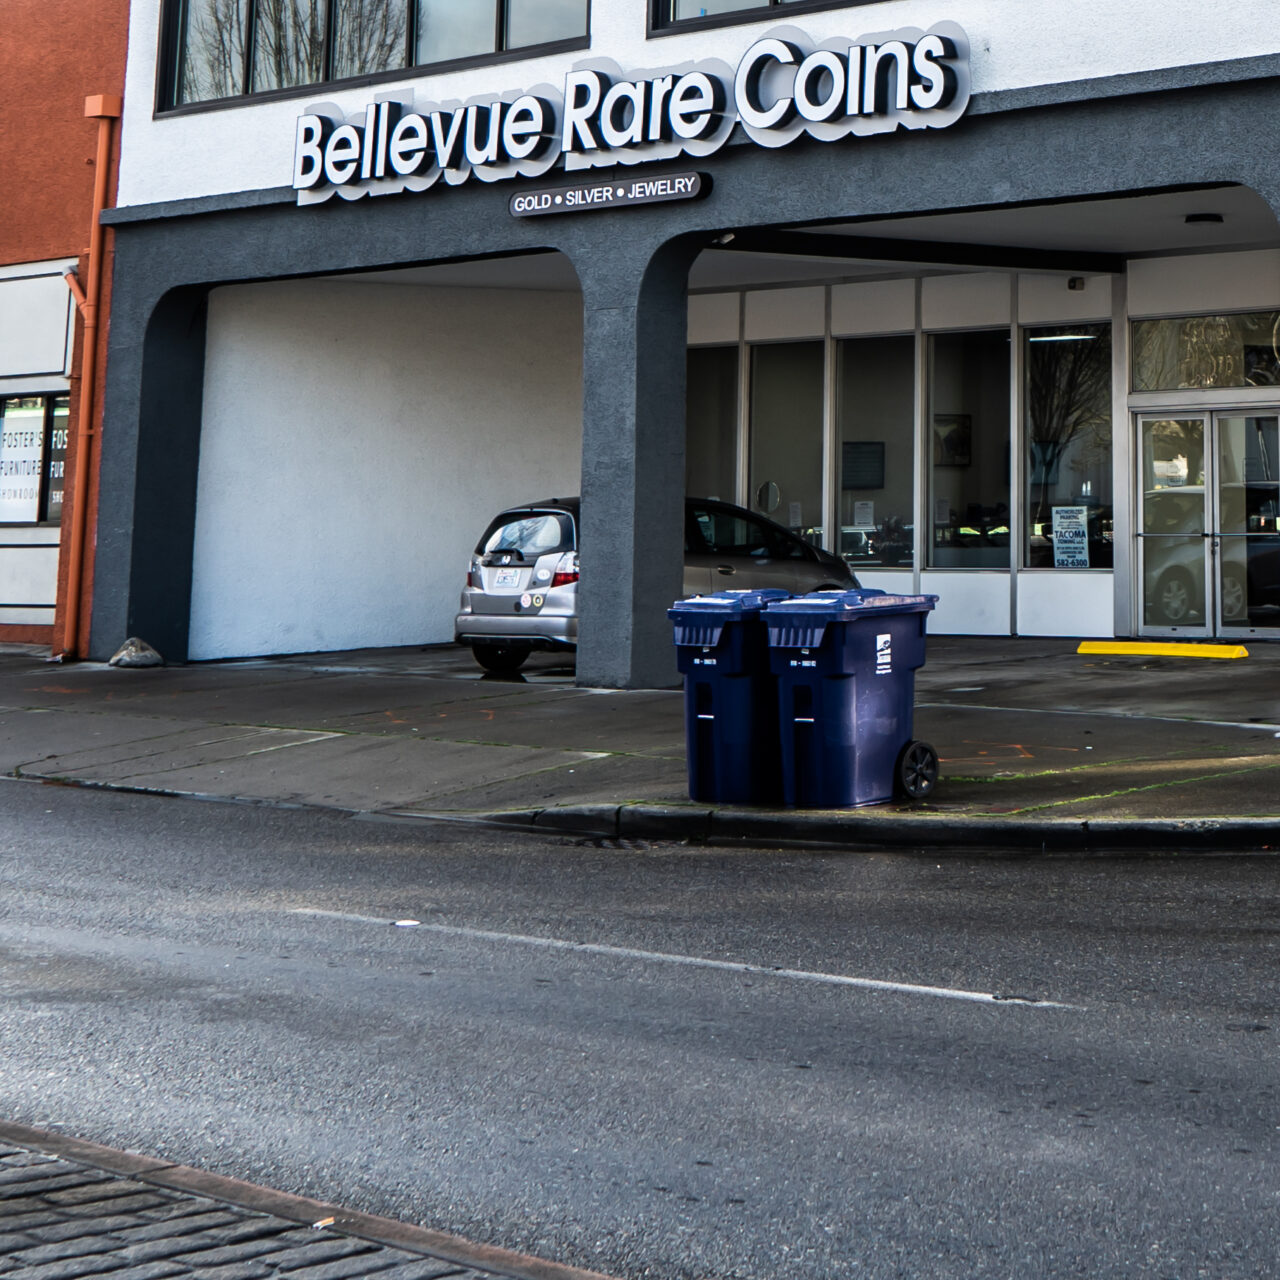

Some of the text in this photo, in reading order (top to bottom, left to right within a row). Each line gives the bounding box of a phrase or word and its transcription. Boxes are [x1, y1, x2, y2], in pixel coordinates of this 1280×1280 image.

[293, 34, 950, 189] Bellevue Rare Coins
[514, 176, 696, 212] GOLD SILVER JEWELRY
[2, 432, 43, 448] FOSTER'S
[0, 460, 41, 476] FURNITURE
[1055, 530, 1086, 538] TACOMA
[1057, 559, 1087, 567] 582-6300
